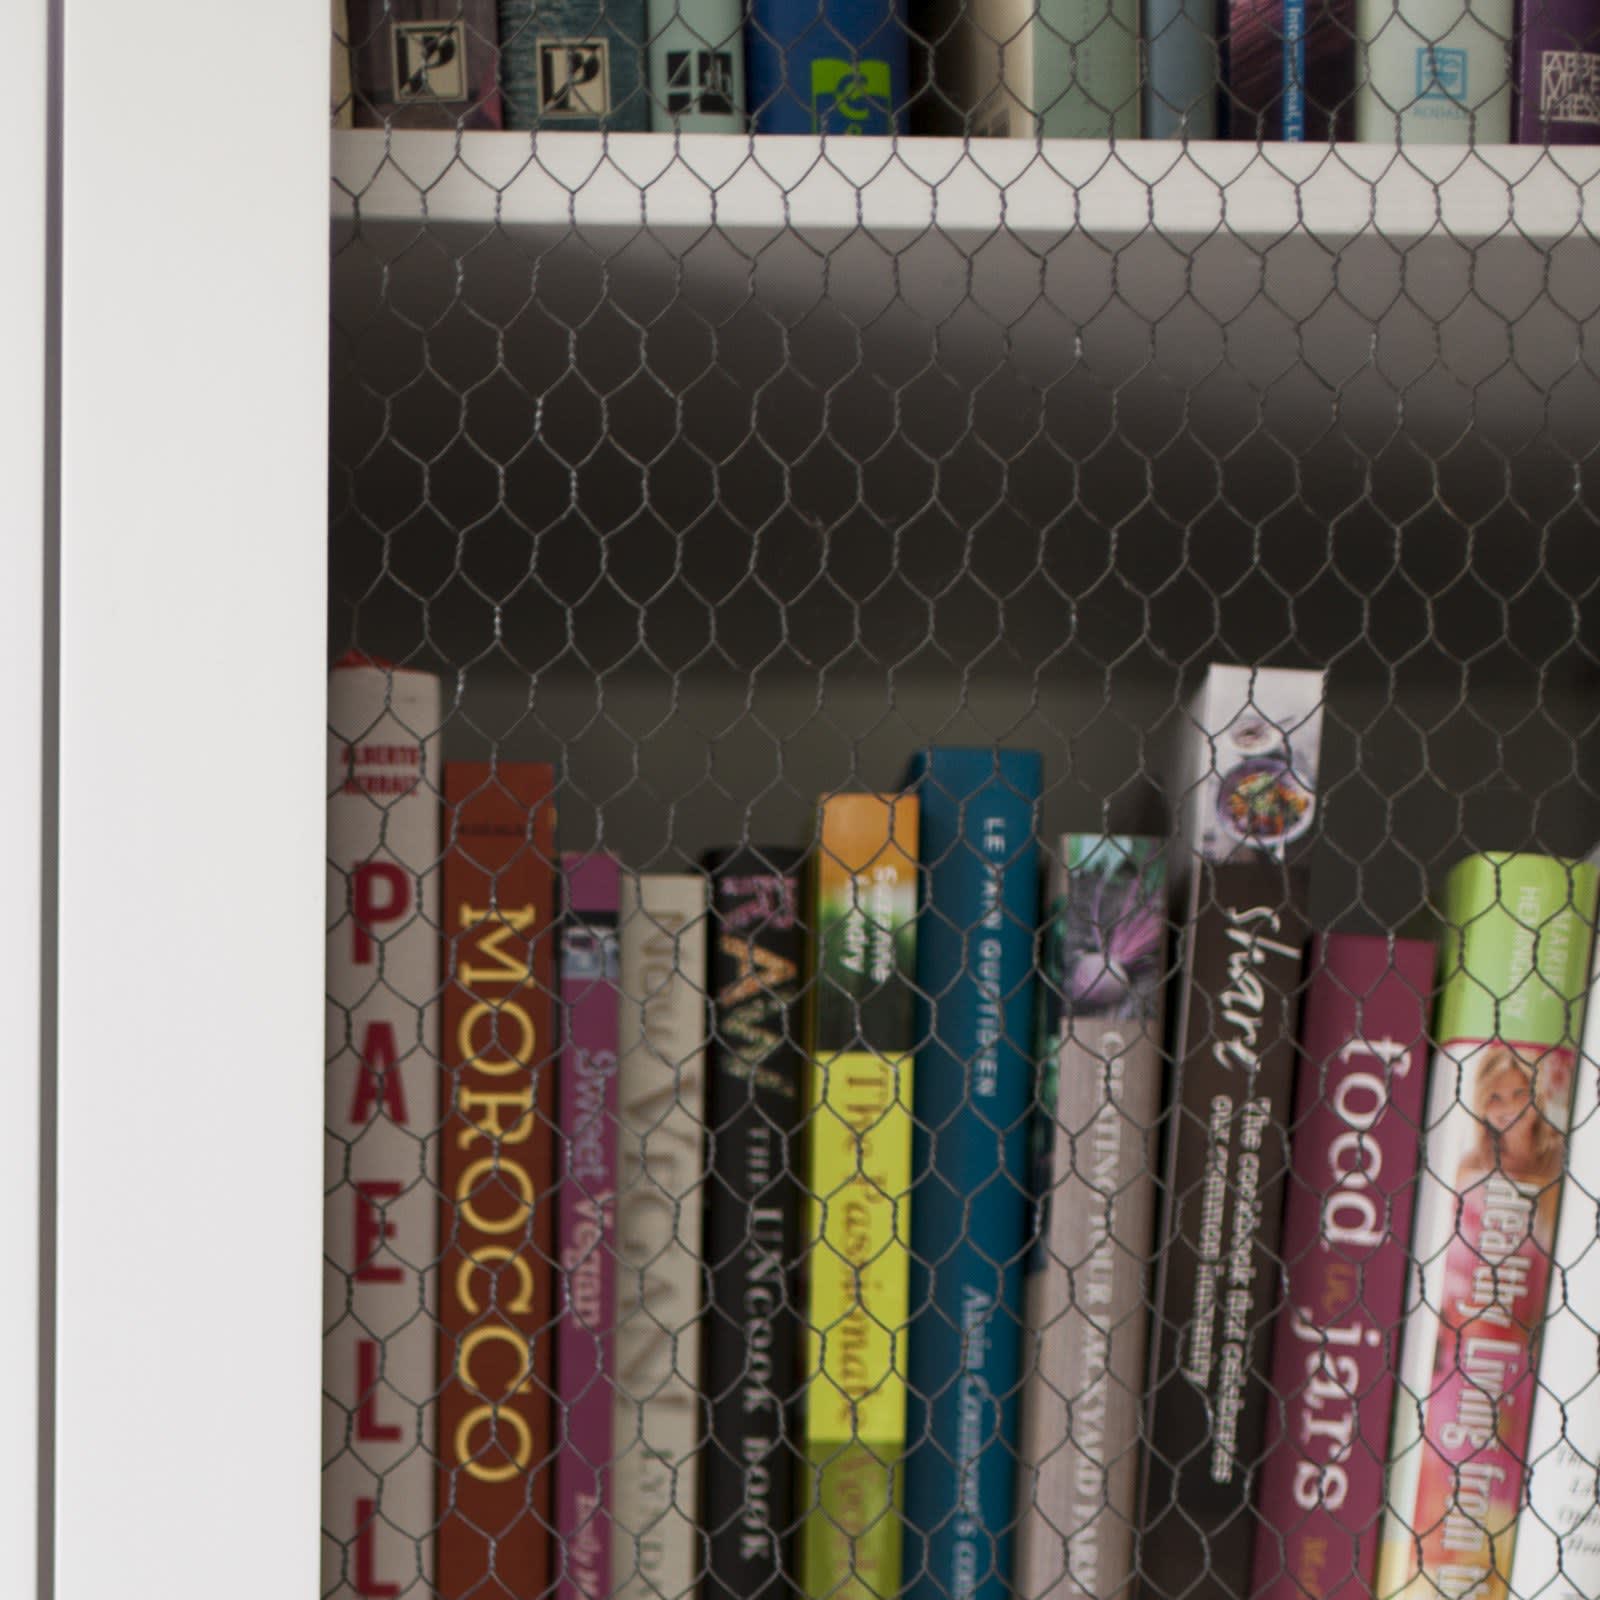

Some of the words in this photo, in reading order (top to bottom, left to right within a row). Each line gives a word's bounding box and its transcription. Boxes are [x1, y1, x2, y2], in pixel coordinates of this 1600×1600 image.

[983, 816, 1004, 853] LE
[719, 870, 799, 1100] RAW
[1217, 903, 1300, 1073] Share
[571, 1046, 617, 1179] Sweet
[1320, 1034, 1412, 1252] food
[455, 903, 537, 1482] MOROCCO
[561, 1188, 616, 1329] Vegan
[1459, 1173, 1542, 1328] Healthy
[1290, 1305, 1383, 1511] jars
[1440, 1336, 1526, 1450] Living
[1442, 1459, 1507, 1552] from
